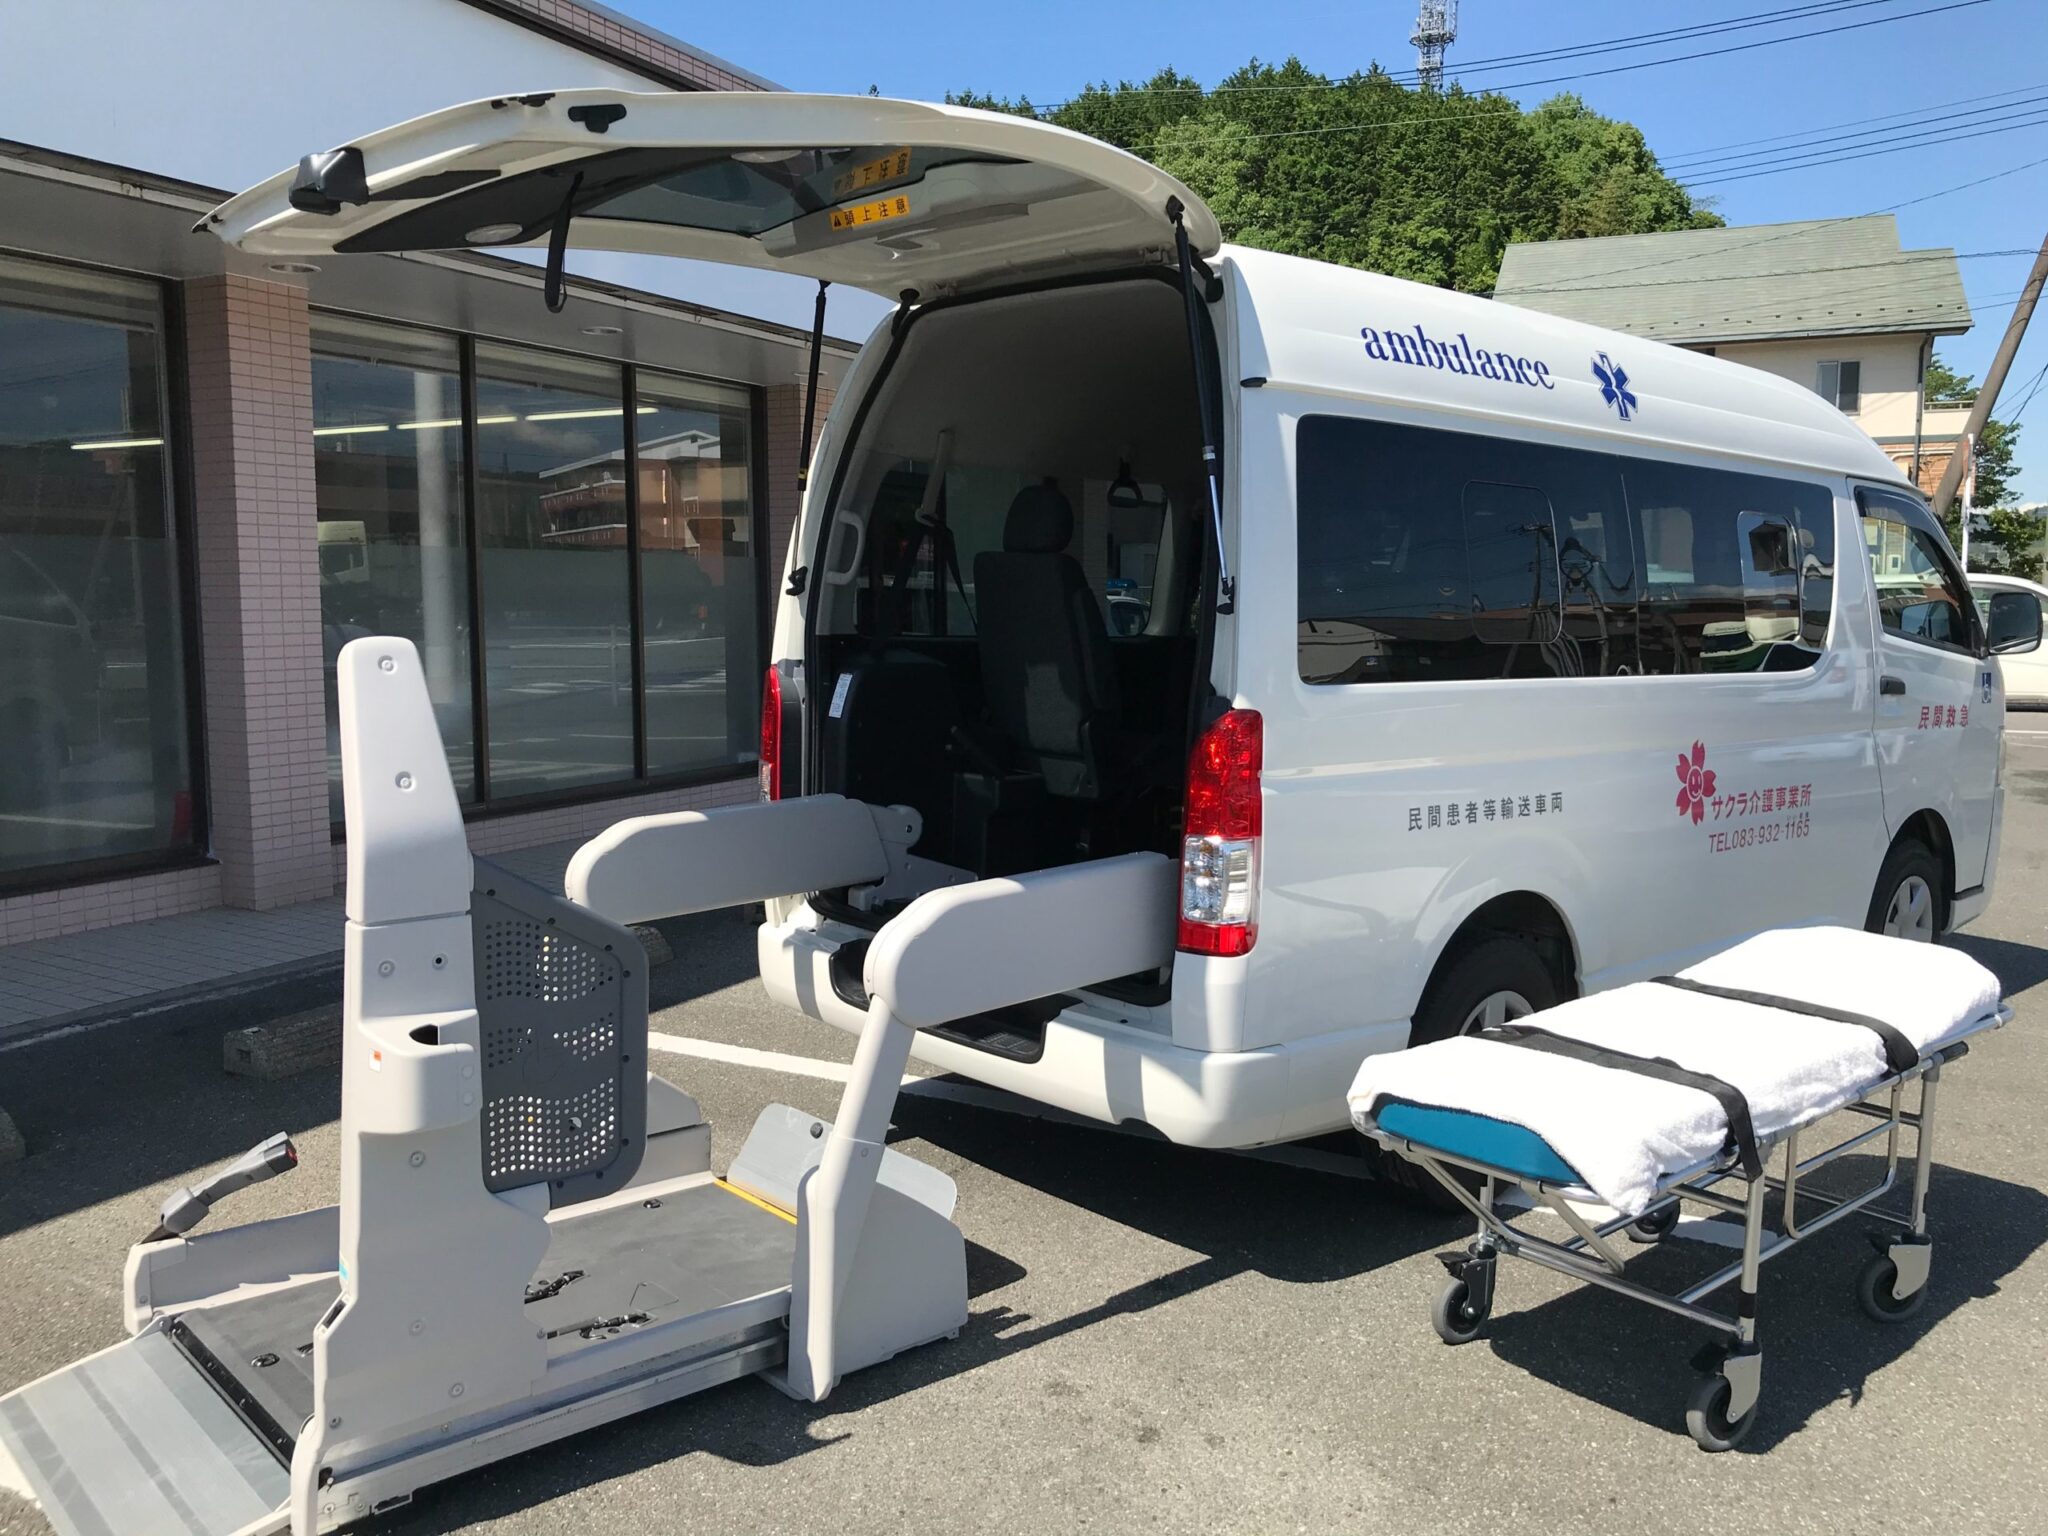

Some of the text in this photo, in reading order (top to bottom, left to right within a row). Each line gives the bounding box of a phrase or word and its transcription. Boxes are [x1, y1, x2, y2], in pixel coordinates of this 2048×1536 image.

[844, 198, 905, 226] 頭上注意
[1361, 325, 1555, 390] ambulance
[1918, 704, 1969, 730] 民間救急
[1408, 791, 1563, 832] 民間患者等輸送車両
[1711, 784, 1812, 821] サクラ介護事業所
[1708, 818, 1811, 854] TEL083-932-1165
